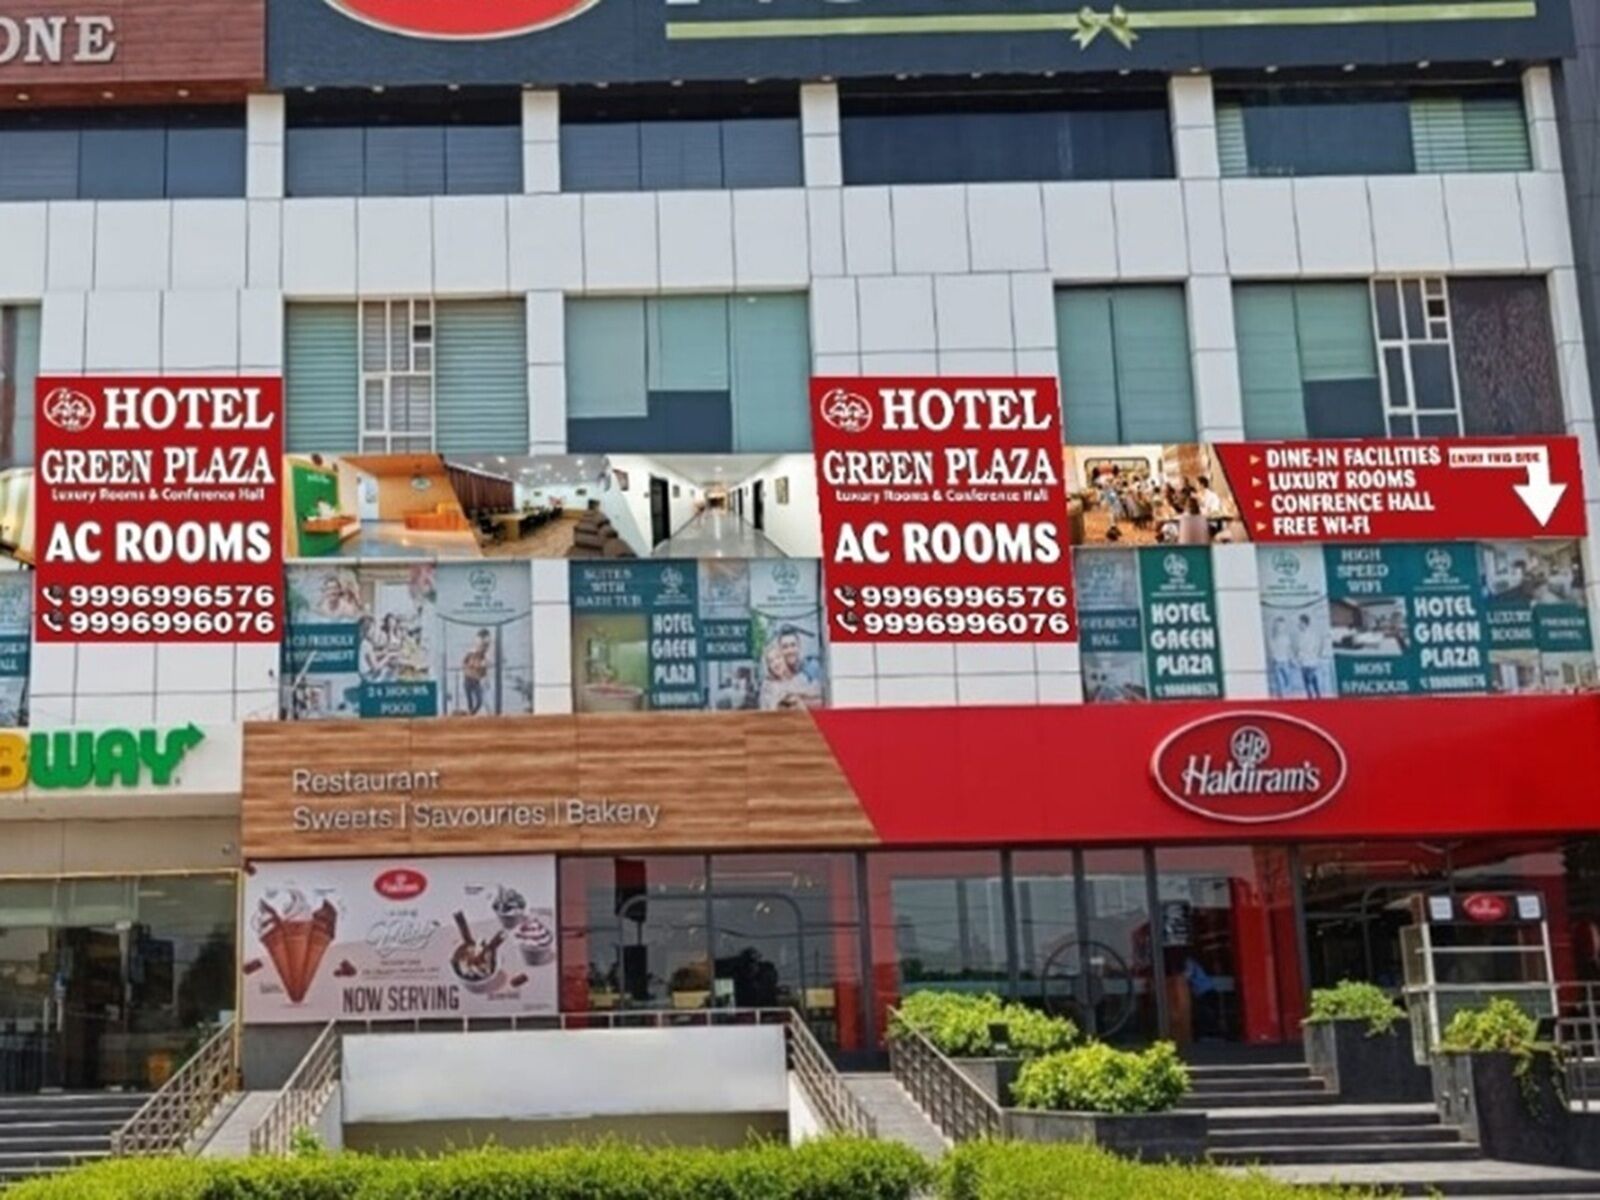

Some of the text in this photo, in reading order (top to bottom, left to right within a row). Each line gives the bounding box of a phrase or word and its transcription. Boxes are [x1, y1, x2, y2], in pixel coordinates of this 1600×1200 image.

[103, 387, 275, 430] HOTEL
[879, 388, 1052, 431] HOTEL
[41, 447, 275, 485] GREEN PLAZA
[823, 448, 1057, 486] GREEN PLAZA
[1266, 445, 1441, 468] DINE-IN FACILITIES
[1268, 469, 1417, 491] LUXURY ROOMS
[52, 487, 264, 504] Luxury Rooms & Conference Hall
[835, 489, 880, 505] Luxury
[933, 489, 943, 502] &
[1271, 491, 1435, 513] CONFRENCE HALL
[1272, 515, 1371, 535] FREE WI-FI
[44, 521, 272, 563] AC ROOMS
[833, 522, 1061, 564] AC ROOMS
[1337, 565, 1389, 578] SPEED
[70, 585, 275, 607] 9996996576
[861, 586, 1067, 608] 9996996576
[1413, 596, 1476, 618] HOTEL
[70, 611, 275, 634] 9996996076
[652, 613, 695, 633] HOTEL
[863, 612, 1070, 634] 9996996076
[1151, 603, 1211, 624] HOTEL
[1150, 628, 1215, 650] GREEN
[1413, 621, 1480, 643] GREEN
[651, 638, 697, 658] GREEN
[1420, 647, 1480, 668] PLAZA
[654, 664, 696, 684] PLAZA
[1156, 654, 1214, 676] PLAZA
[292, 768, 439, 793] Restaurant
[1181, 754, 1321, 796] Haldiram's
[292, 805, 393, 831] Sweets
[413, 802, 546, 829] Savouries
[566, 798, 660, 829] Bakery
[342, 983, 460, 1013] NOW SERVING
